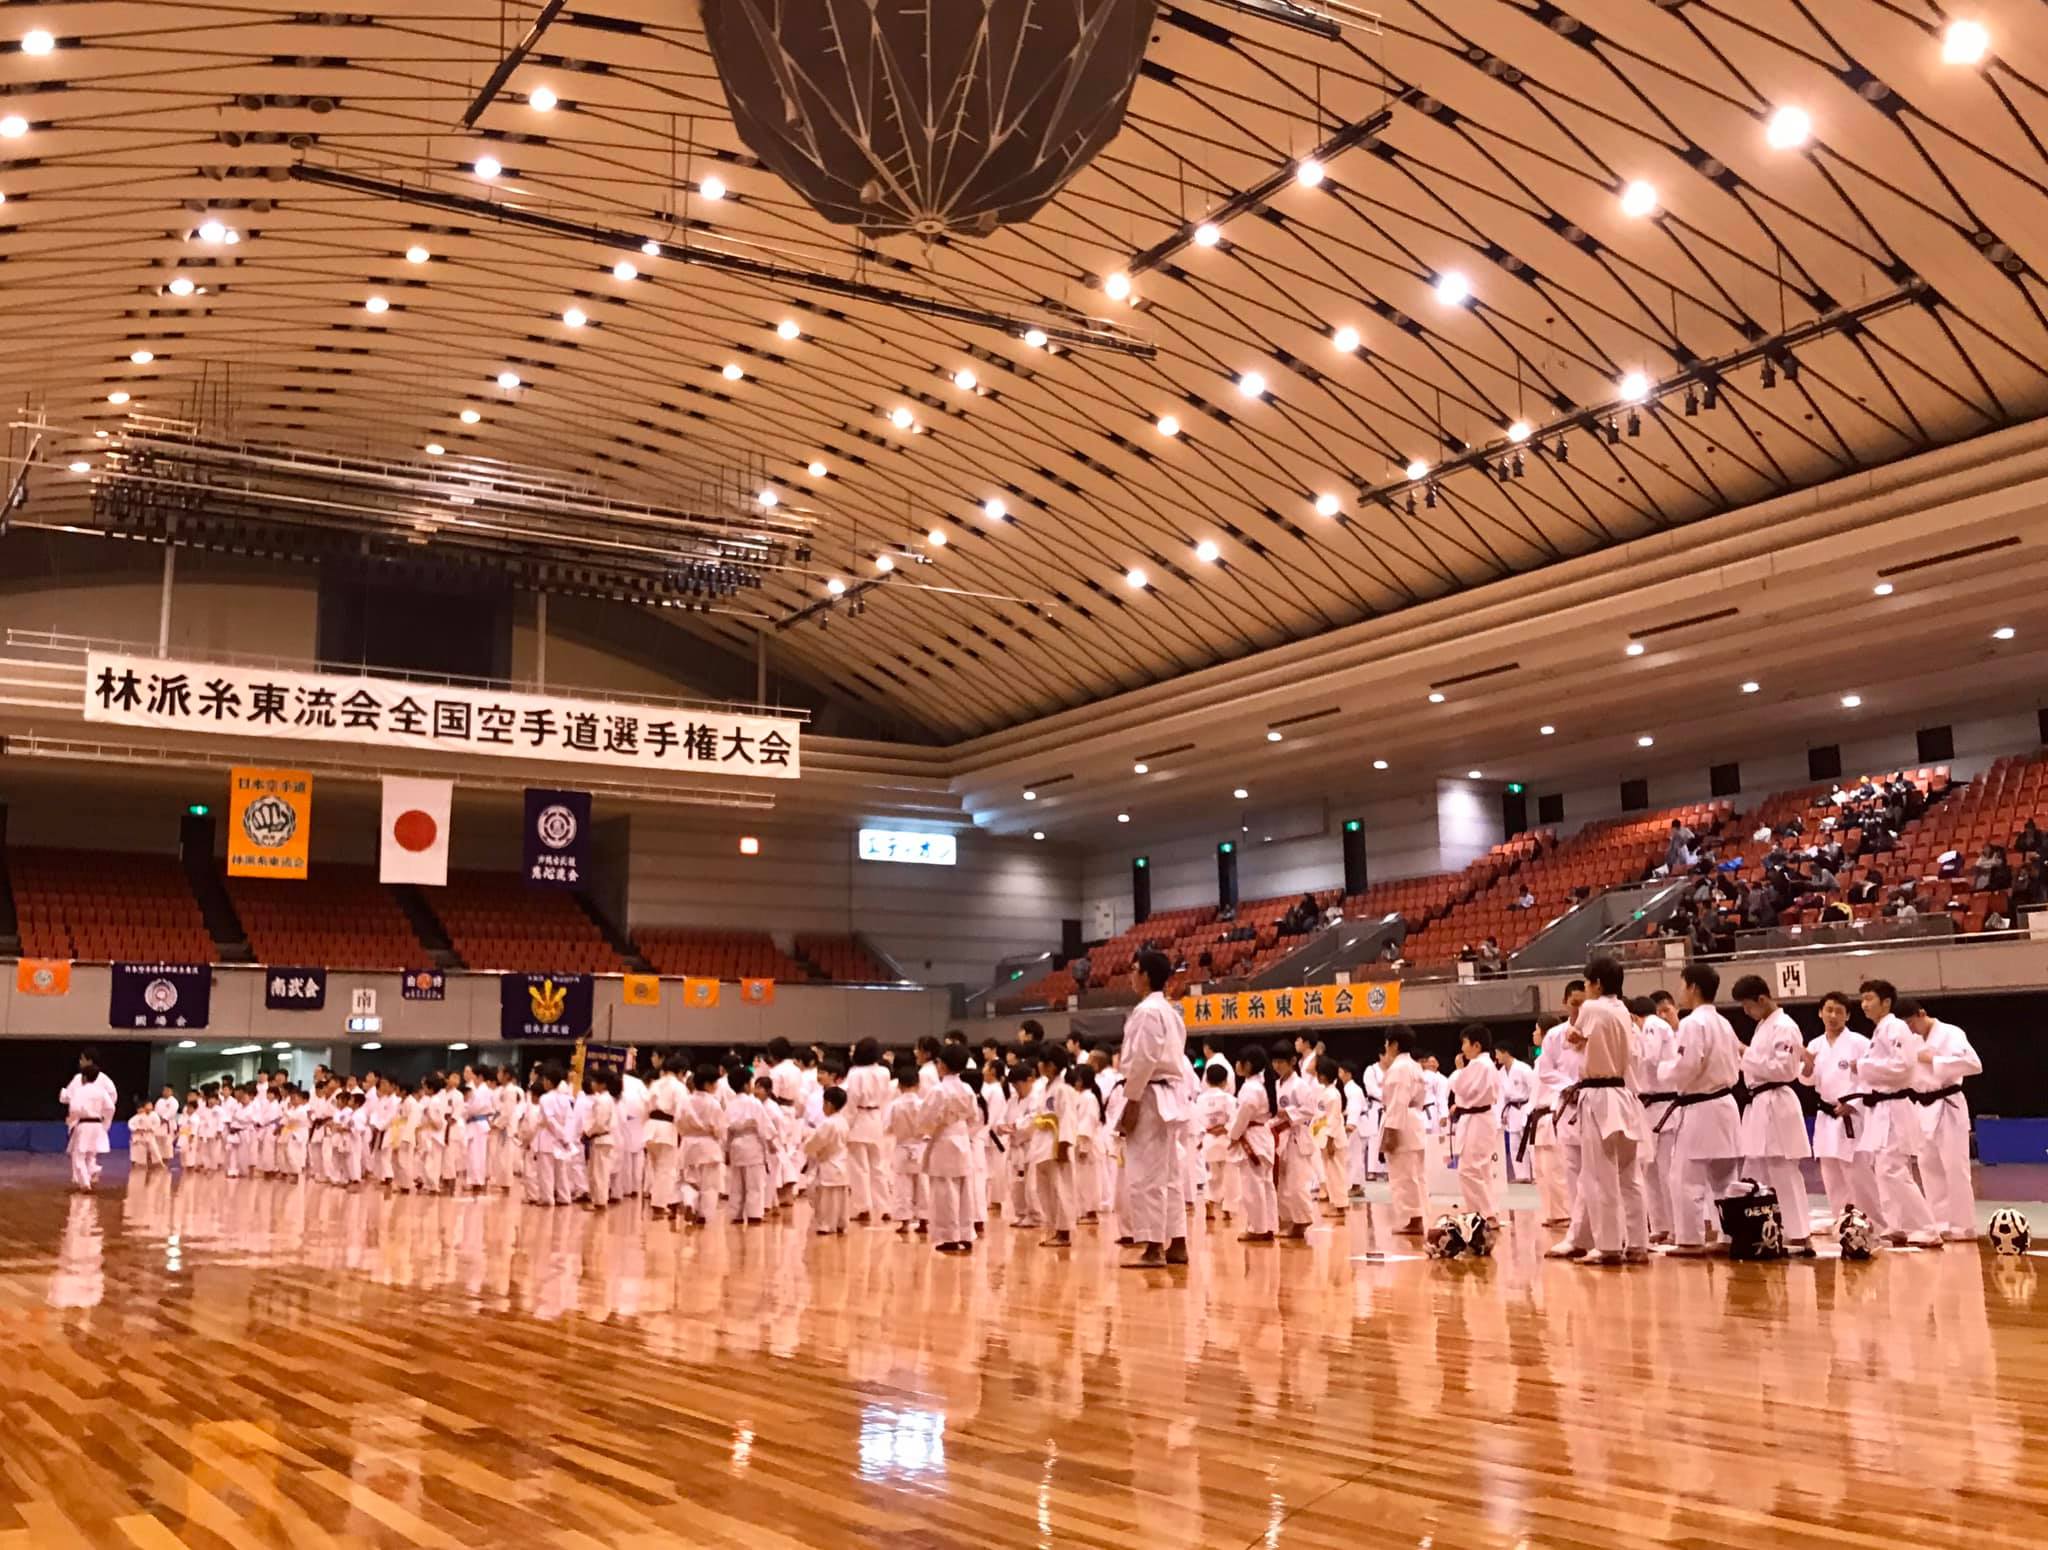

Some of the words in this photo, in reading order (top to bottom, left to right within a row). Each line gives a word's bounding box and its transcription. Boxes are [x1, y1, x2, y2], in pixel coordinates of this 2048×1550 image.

[95, 667, 791, 767] 林派糸東流会全国空手道選手権大会
[239, 778, 306, 793] 日本空手道
[271, 977, 321, 998] 南武会
[1195, 988, 1353, 1021] 林派糸東流会
